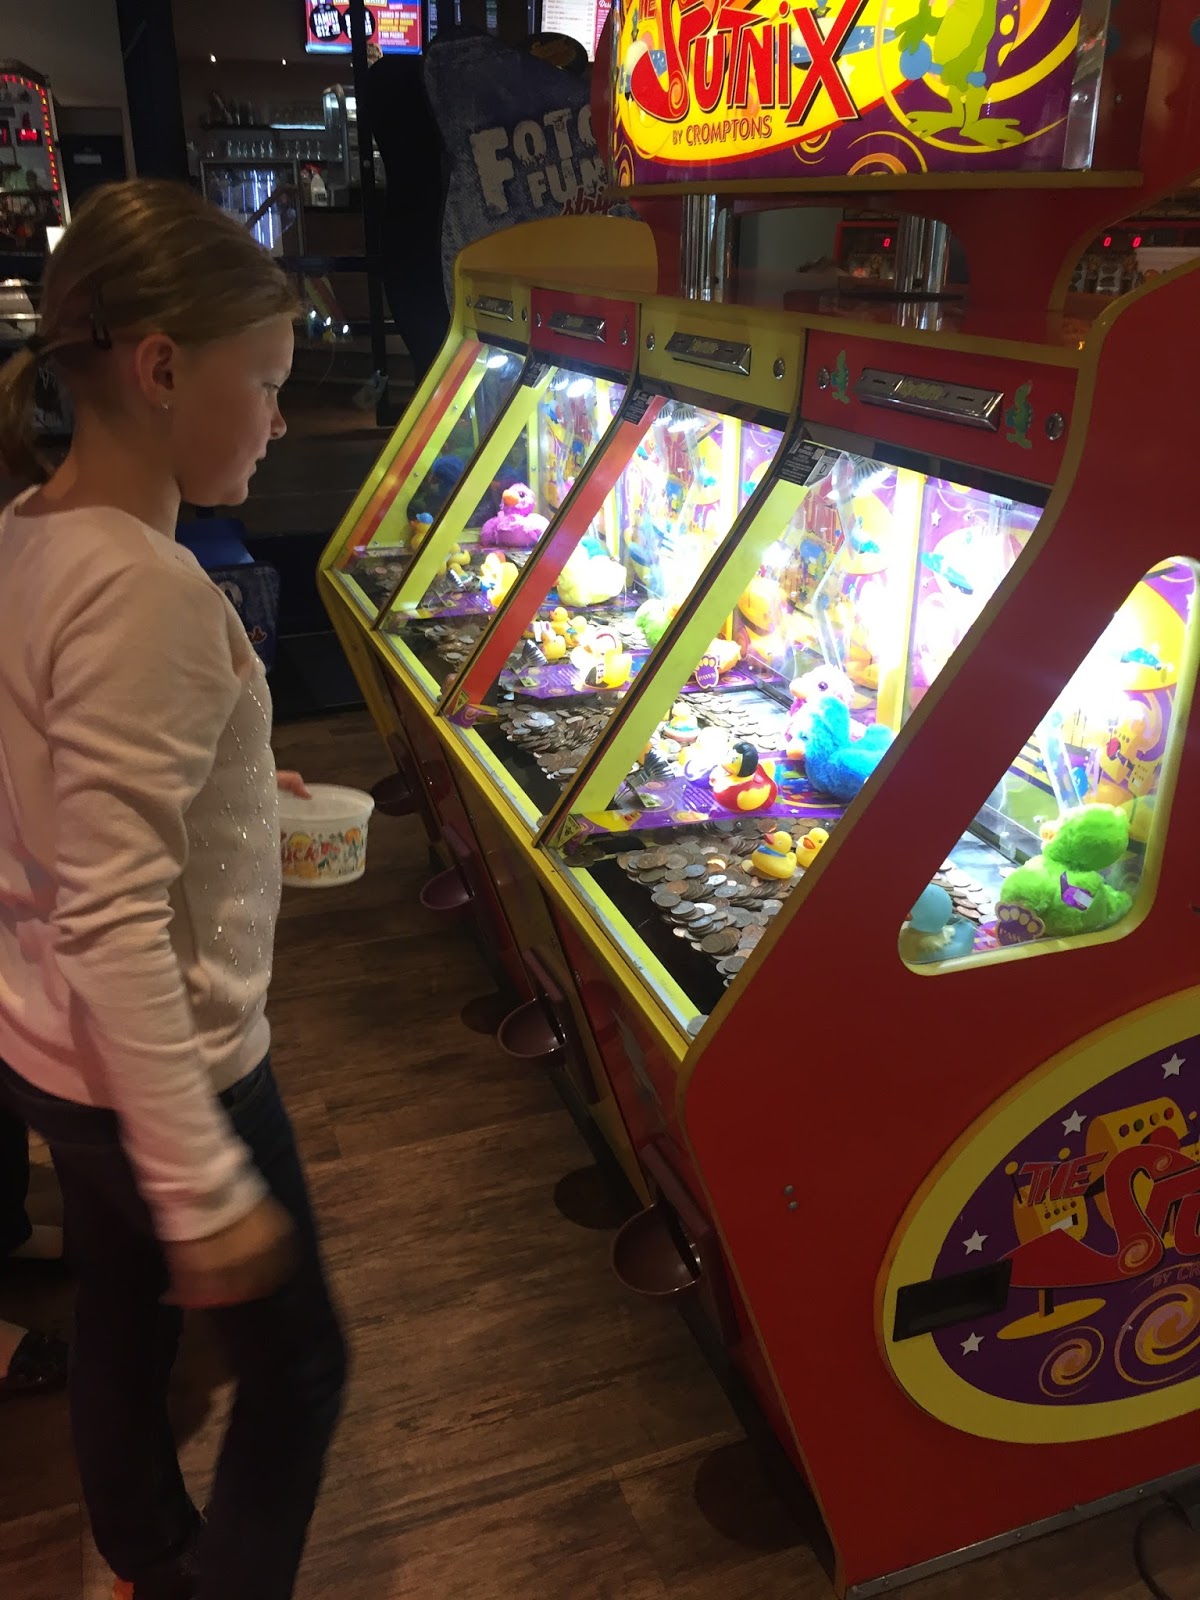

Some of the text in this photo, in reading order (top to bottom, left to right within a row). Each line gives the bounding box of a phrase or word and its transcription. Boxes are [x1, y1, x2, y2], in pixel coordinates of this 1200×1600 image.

[313, 10, 339, 26] FAMILY
[672, 115, 773, 147] BY CROMPTONS
[1018, 1150, 1109, 1208] THE
